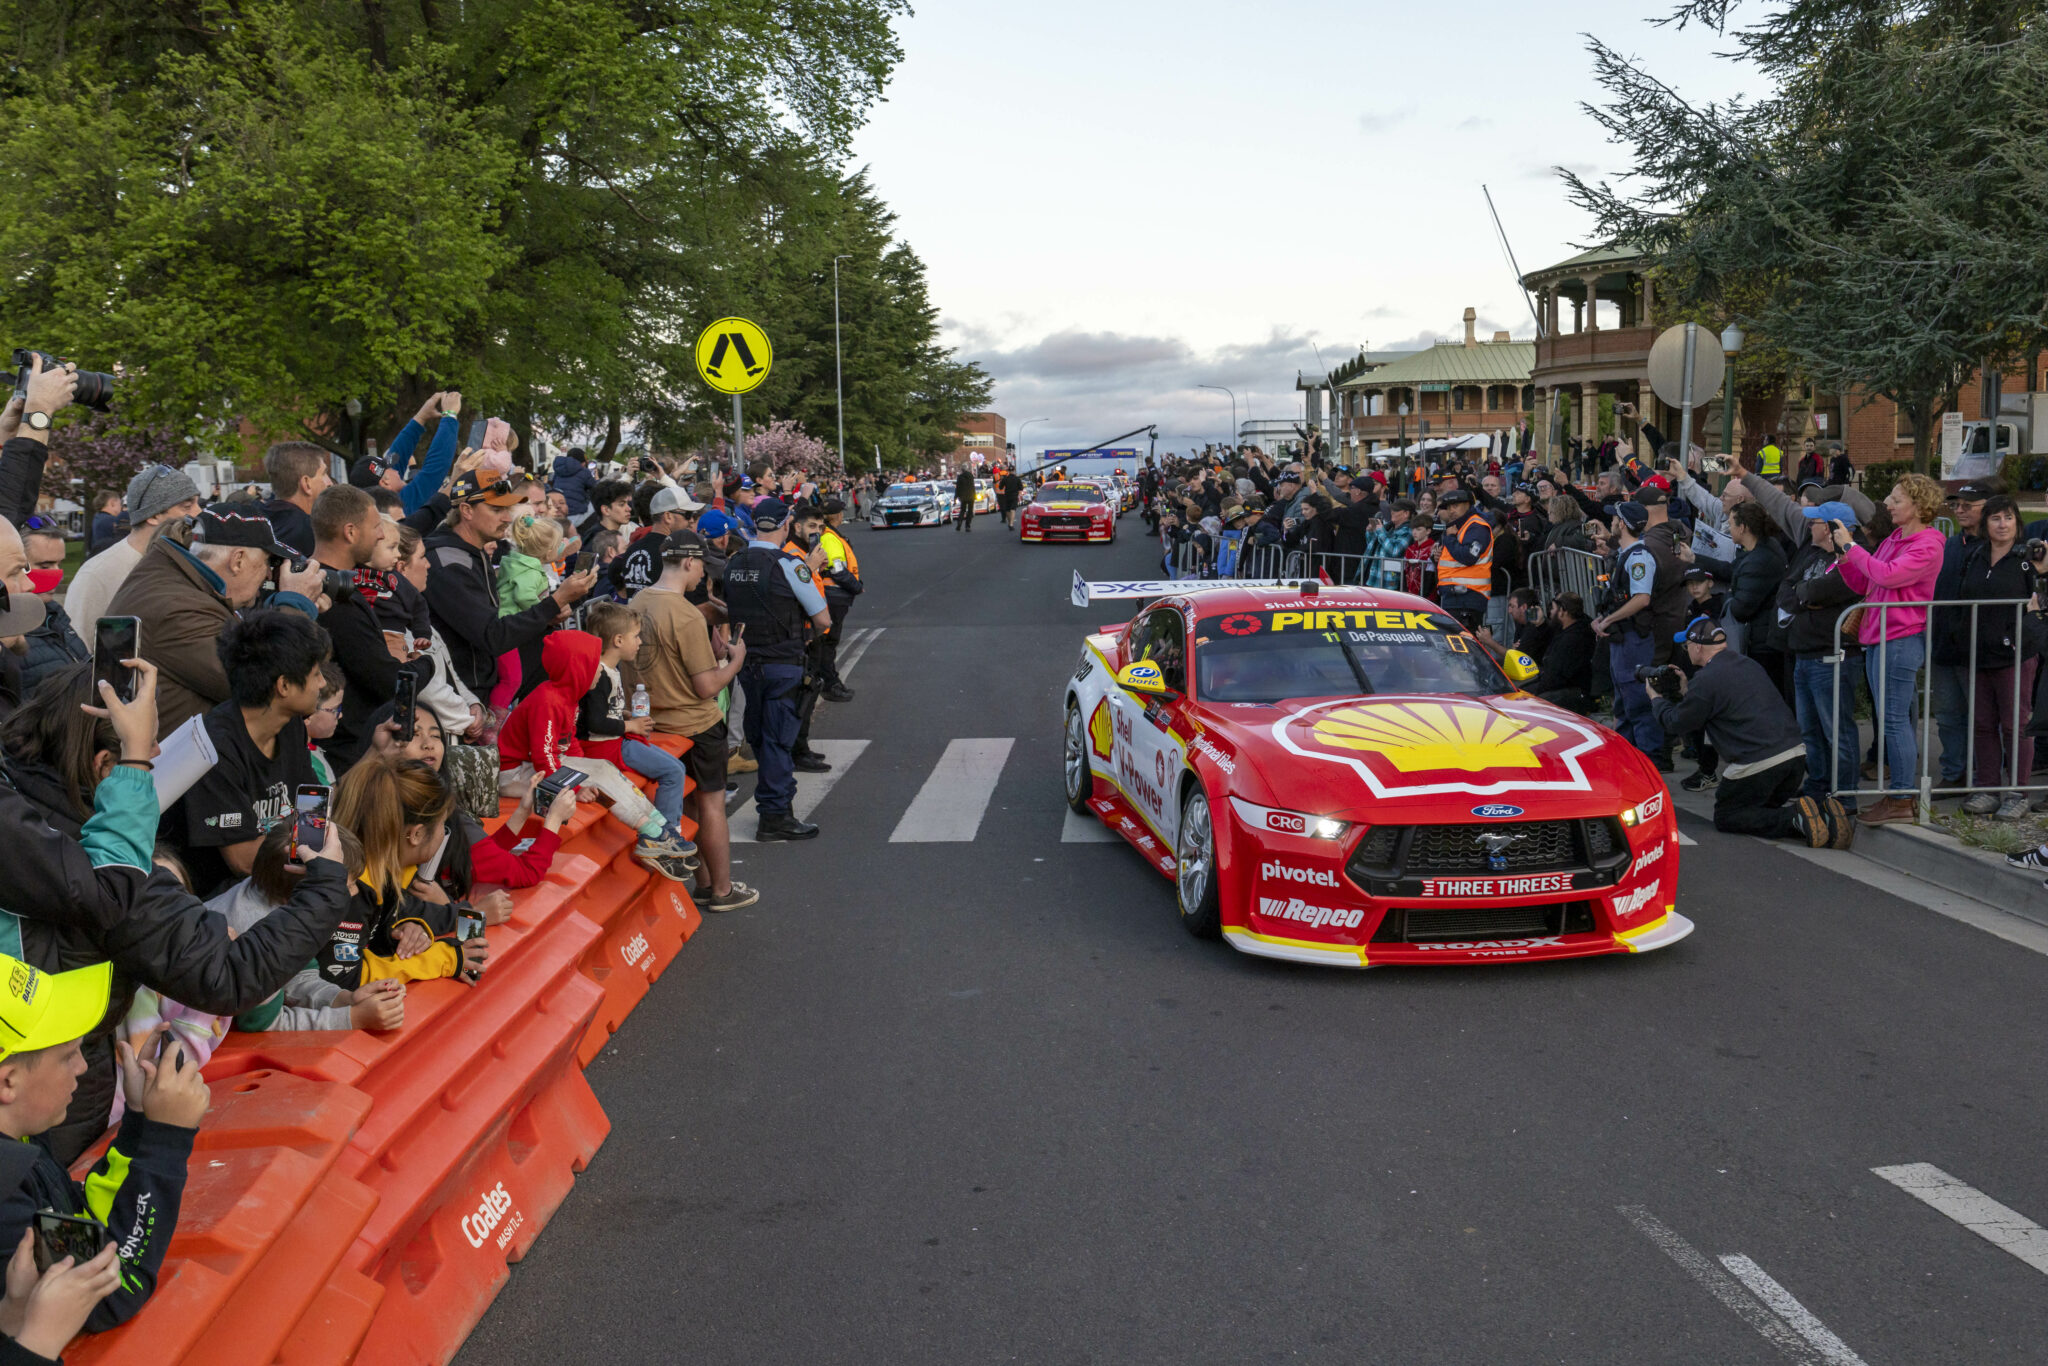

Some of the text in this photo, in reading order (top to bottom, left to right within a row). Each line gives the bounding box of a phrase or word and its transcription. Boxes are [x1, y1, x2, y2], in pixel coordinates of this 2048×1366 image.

[730, 573, 760, 582] POLICE
[1264, 600, 1305, 609] Shell
[1271, 611, 1438, 631] PIRTEK
[1128, 677, 1159, 686] Doric
[1117, 708, 1133, 746] Shell
[1117, 740, 1163, 819] V-Power
[1481, 804, 1515, 816] Ford
[1268, 814, 1304, 830] CRC
[1437, 876, 1561, 896] THREE THREES
[1282, 897, 1365, 928] Repco
[621, 932, 649, 967] Coates
[1413, 936, 1566, 951] ROADX
[9, 966, 27, 998] 46
[462, 1181, 512, 1249] Coates
[117, 1191, 151, 1262] ONSTER
